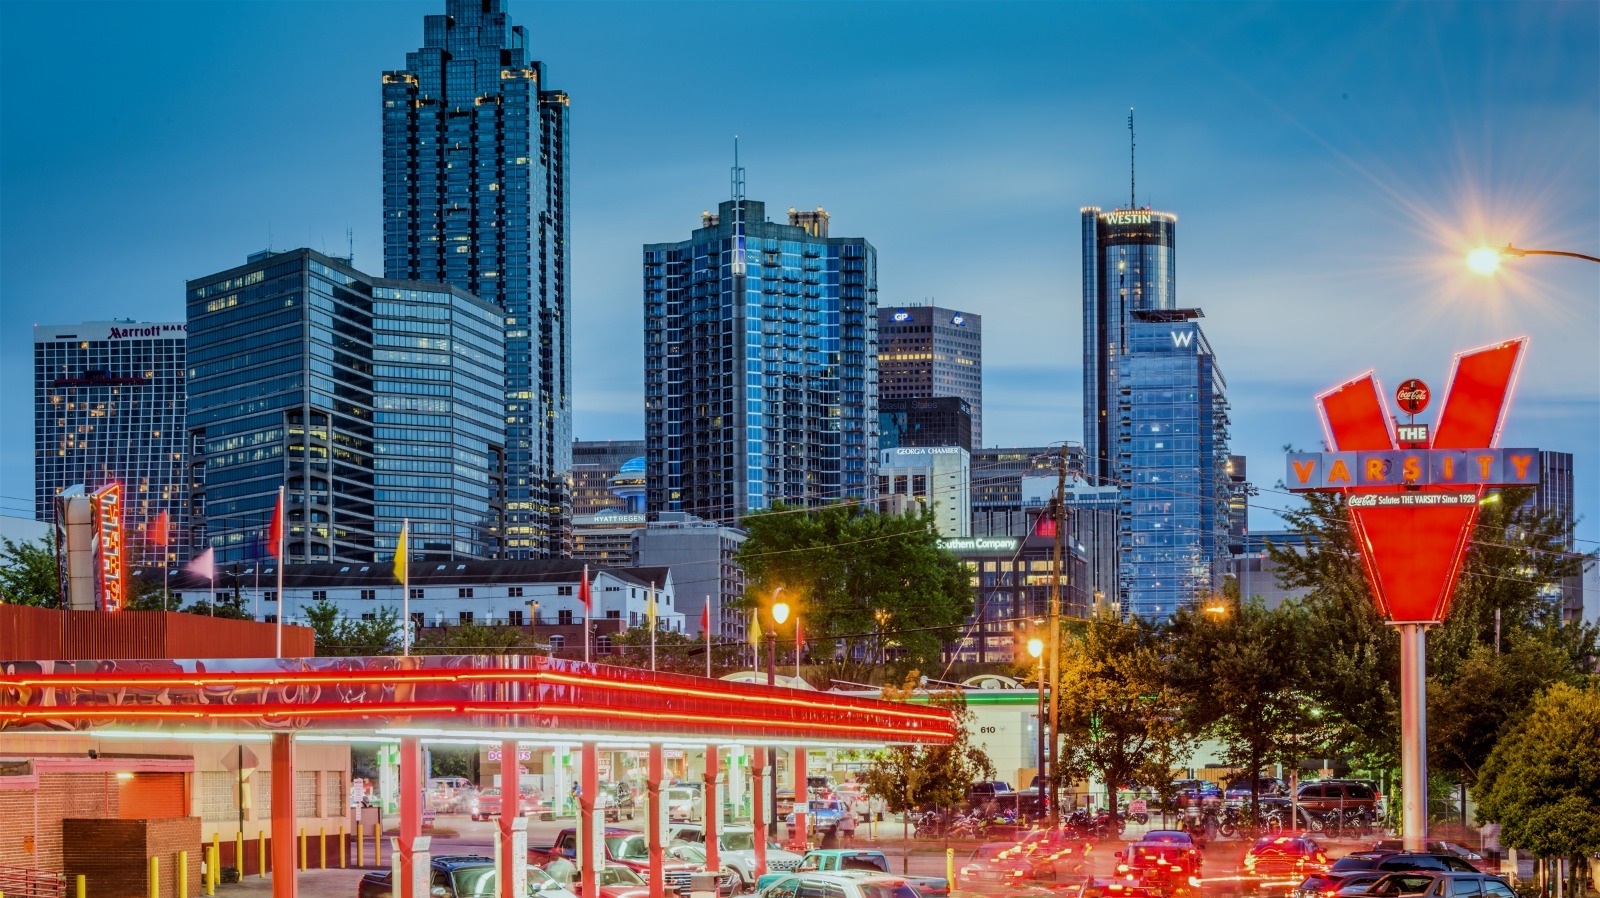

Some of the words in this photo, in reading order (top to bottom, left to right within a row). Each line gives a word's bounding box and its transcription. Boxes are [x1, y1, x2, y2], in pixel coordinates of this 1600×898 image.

[1106, 214, 1151, 224] WESTIN
[895, 313, 908, 321] GP
[107, 326, 160, 339] Marriott
[1171, 331, 1193, 347] W
[912, 400, 938, 410] States
[1398, 427, 1427, 440] THE
[1292, 456, 1532, 483] VARSITY
[1379, 495, 1400, 505] Salutes
[1401, 495, 1414, 504] THE
[1415, 494, 1441, 504] VARSITY
[1442, 494, 1458, 503] Since
[1459, 493, 1476, 503] 1928
[936, 539, 974, 549] Southern
[976, 538, 1016, 550] Company
[981, 726, 996, 734] 610
[489, 750, 531, 760] DOTS
